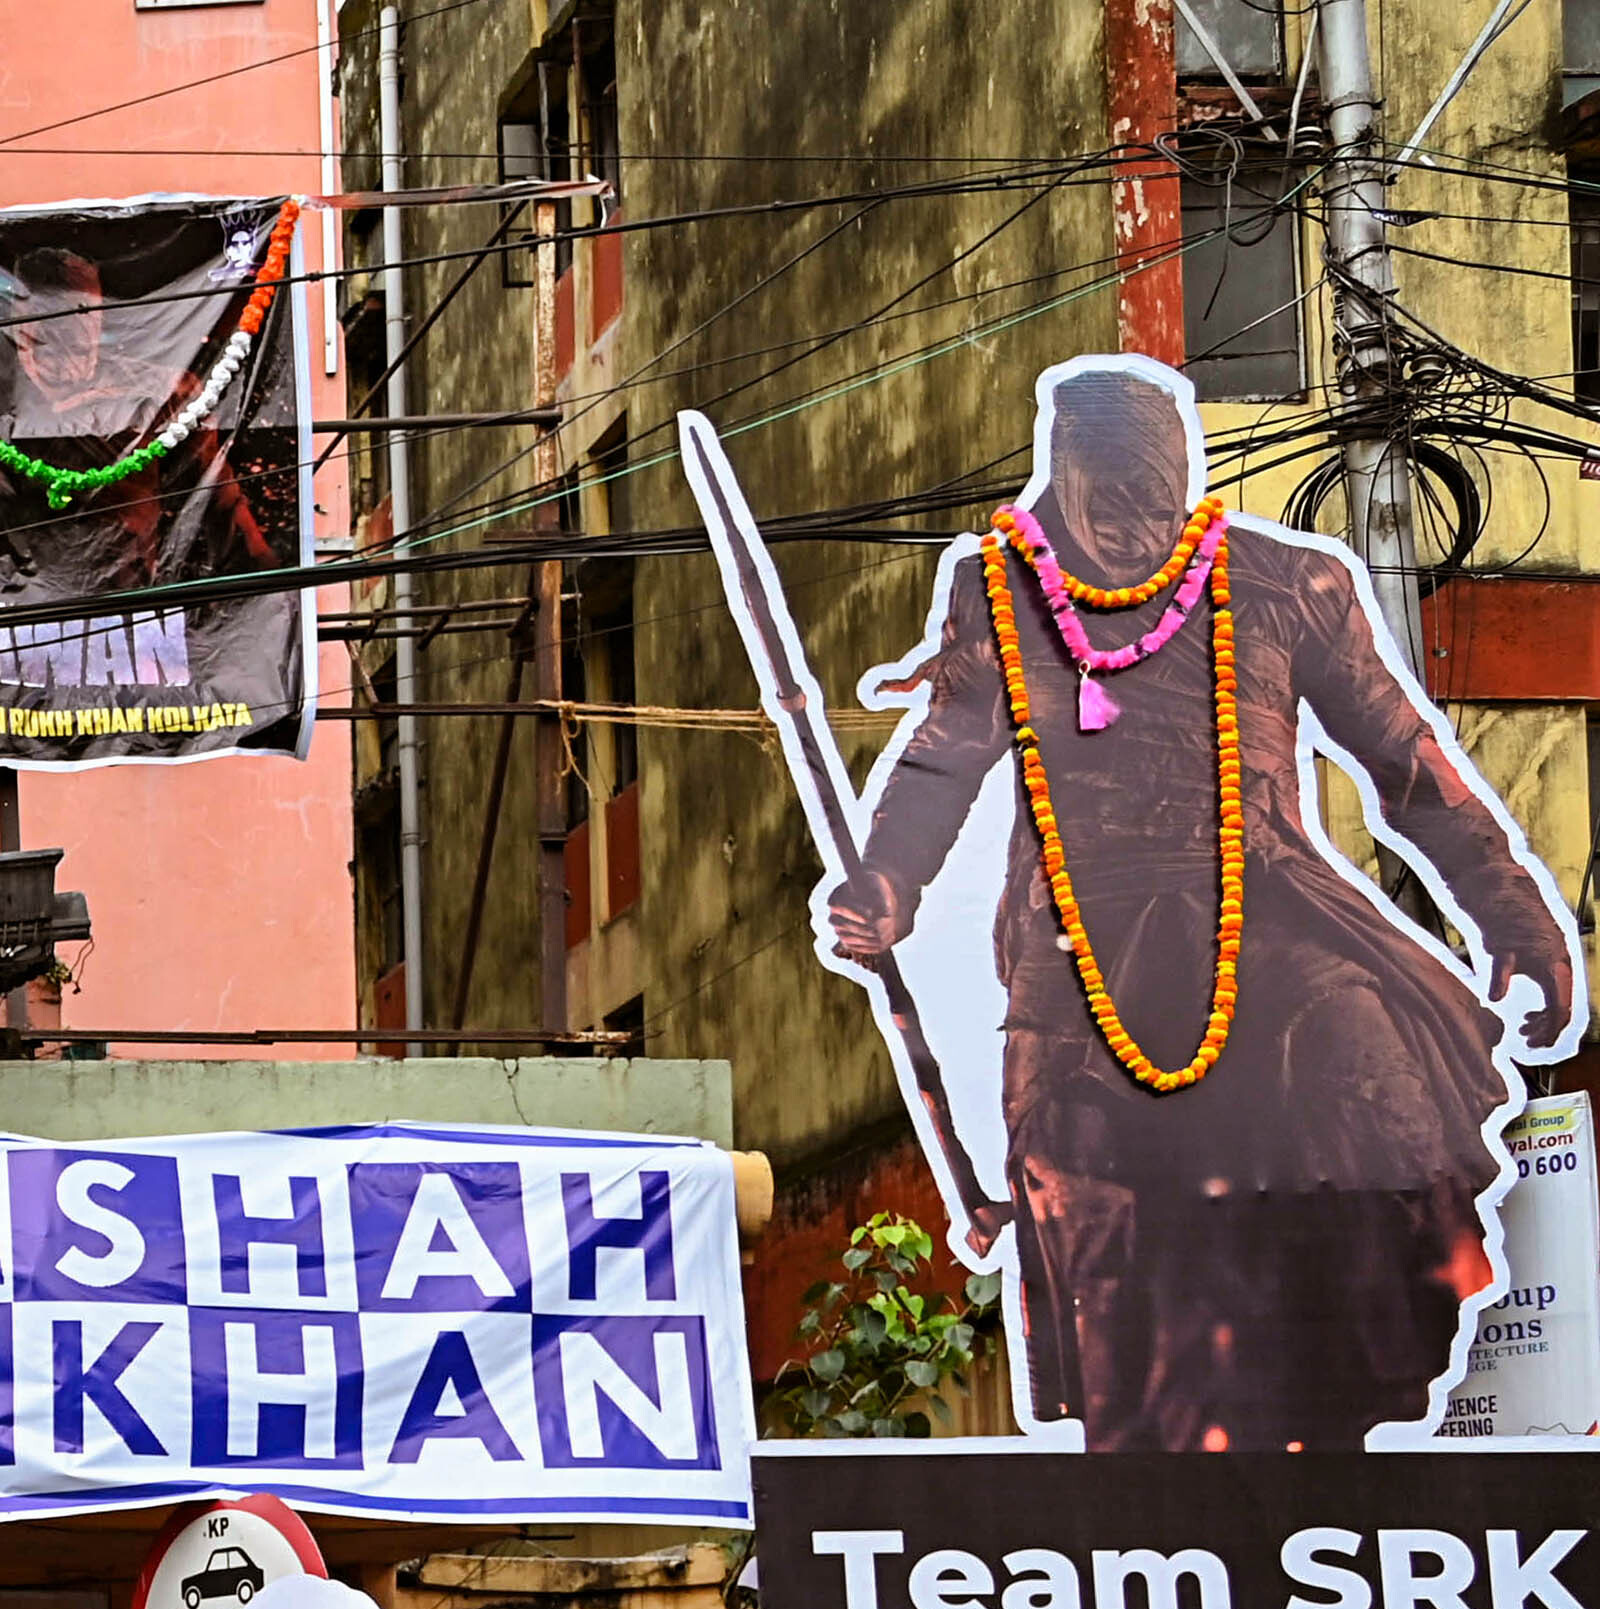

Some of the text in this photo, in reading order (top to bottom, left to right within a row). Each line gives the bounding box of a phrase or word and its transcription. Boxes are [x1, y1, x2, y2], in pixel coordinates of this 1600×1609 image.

[9, 706, 73, 738] RUKH
[76, 705, 144, 736] KHAN
[146, 702, 253, 733] KOLKATA
[1530, 1113, 1565, 1129] Group
[1535, 1152, 1577, 1176] 600
[1492, 1284, 1557, 1311] oup
[207, 1517, 230, 1539] KP
